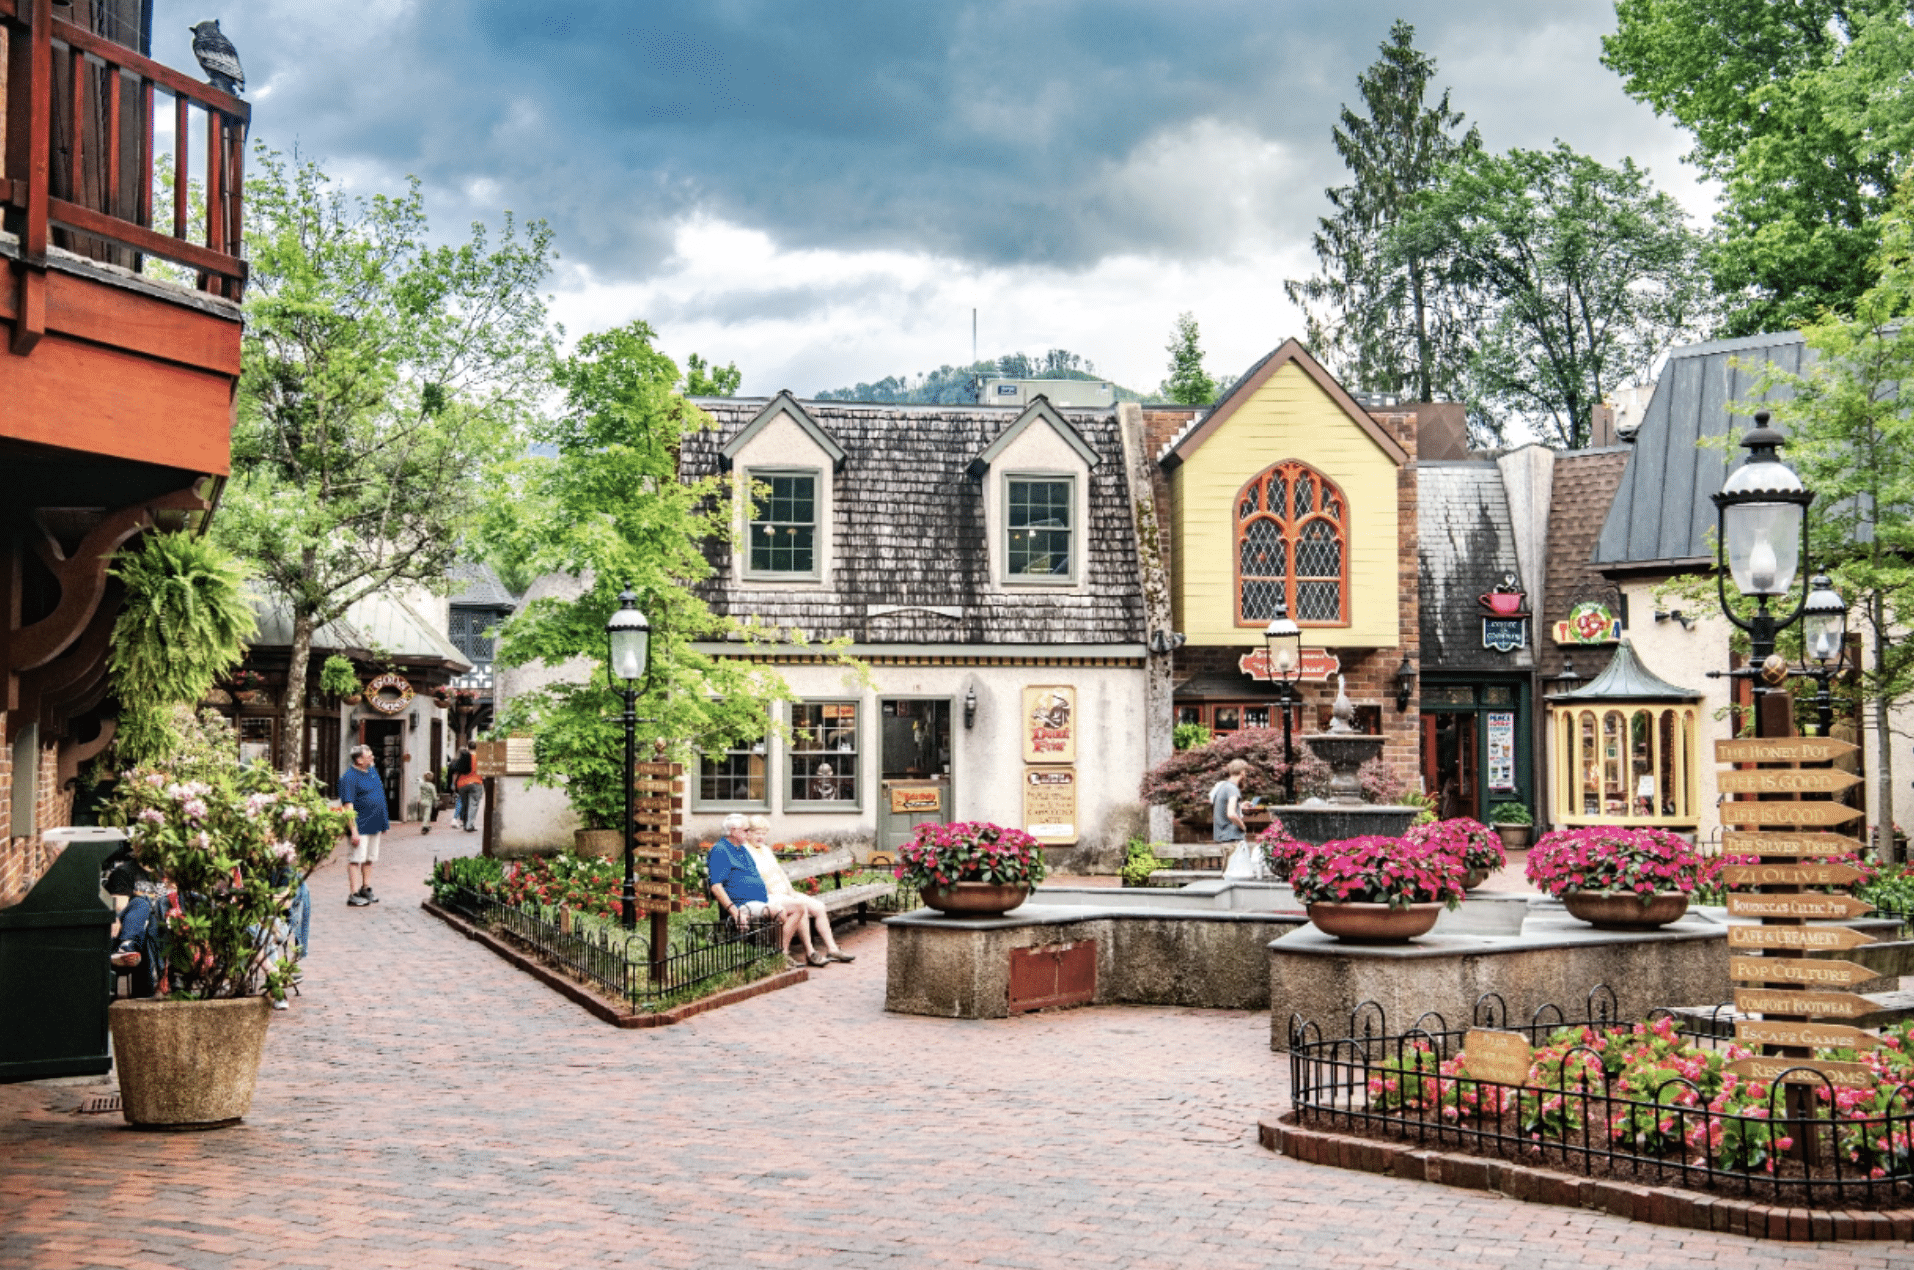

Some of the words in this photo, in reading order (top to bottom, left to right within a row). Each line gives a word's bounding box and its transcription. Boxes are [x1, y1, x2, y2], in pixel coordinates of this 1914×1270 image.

[1718, 745, 1747, 759] THE
[1750, 745, 1798, 758] HONEY
[1802, 744, 1830, 758] POT
[1779, 775, 1832, 789] GOOD
[1725, 806, 1756, 822] LIFE
[1777, 807, 1826, 822] GOOD
[1727, 839, 1753, 851] THE
[1755, 839, 1800, 852] SILVER
[1802, 840, 1838, 853] TREE
[1761, 868, 1831, 882] OLIVE
[1776, 928, 1840, 945] CREAMERY
[1737, 963, 1768, 977] POP
[1772, 964, 1851, 982] CULTURE
[1739, 996, 1790, 1011] COMFORT
[1793, 998, 1853, 1015] FOOTWEAR
[1740, 1025, 1797, 1042] ESCAPE
[1799, 1030, 1855, 1046] GAMES
